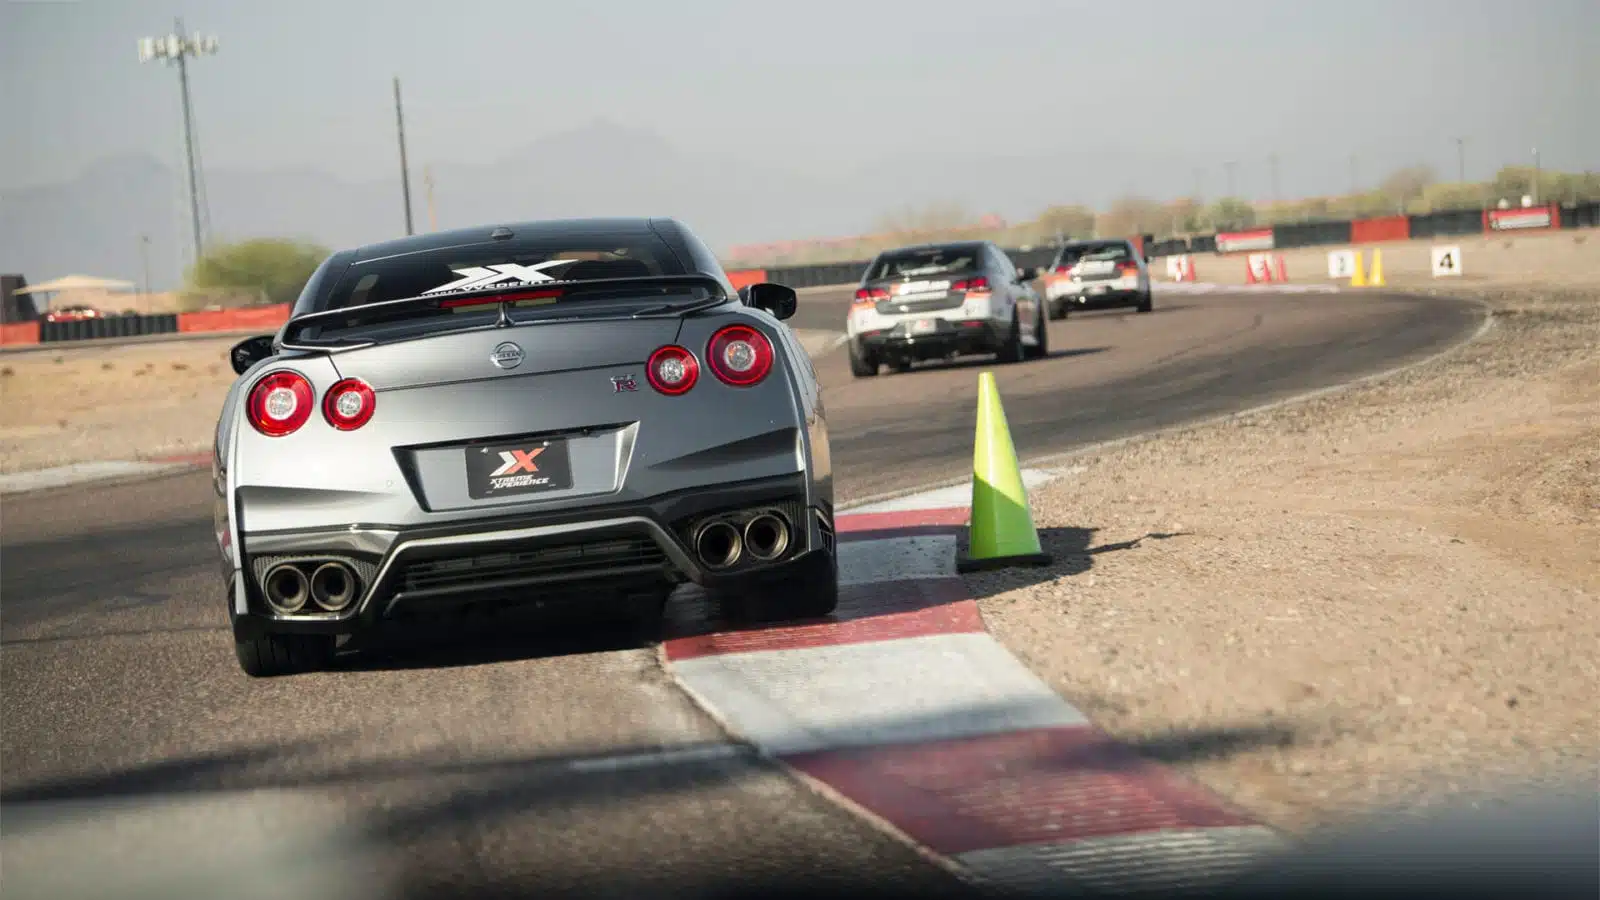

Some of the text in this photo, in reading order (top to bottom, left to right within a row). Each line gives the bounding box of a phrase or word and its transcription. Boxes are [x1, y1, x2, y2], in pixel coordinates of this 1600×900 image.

[1439, 253, 1454, 269] 4
[489, 474, 535, 485] XTREME
[493, 477, 551, 490] XPERIENCE
